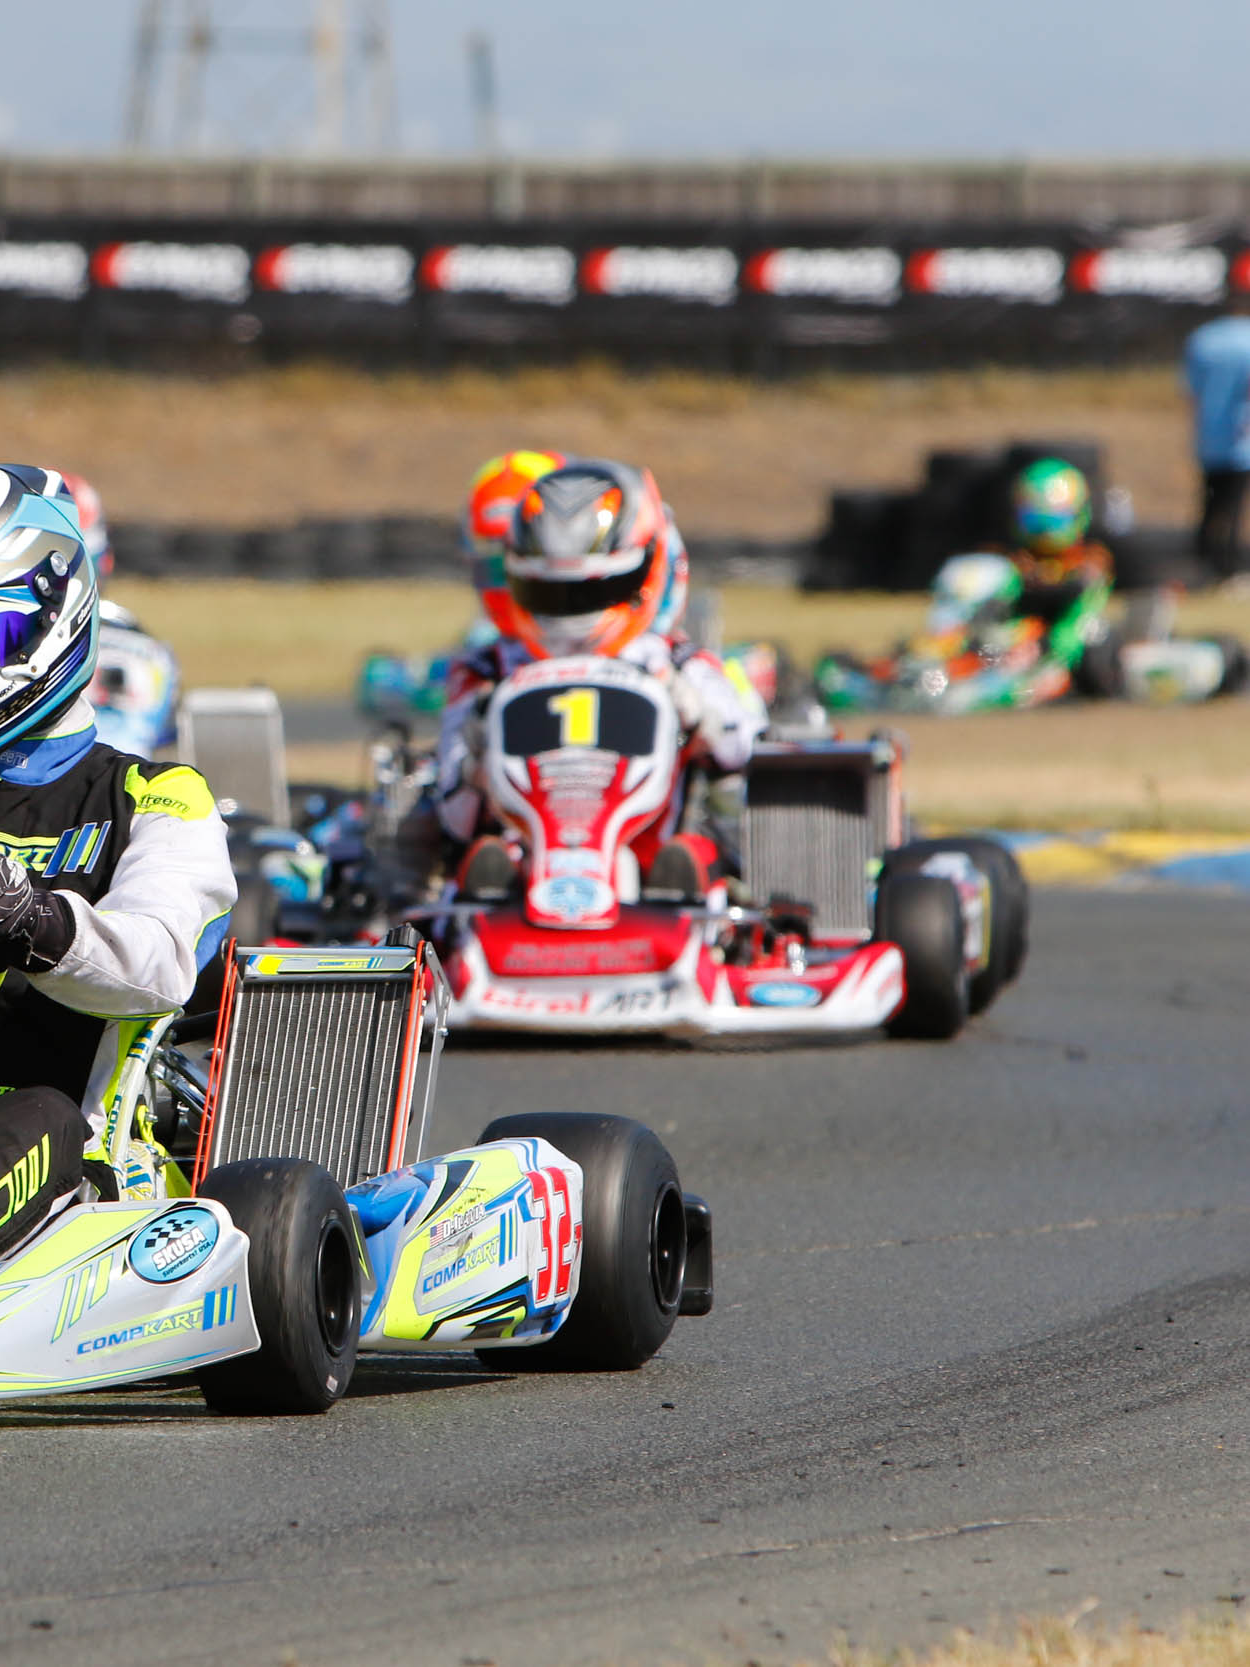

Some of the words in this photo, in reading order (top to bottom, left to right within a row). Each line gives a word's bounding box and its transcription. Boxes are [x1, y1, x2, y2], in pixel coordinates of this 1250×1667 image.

[549, 687, 600, 747] 1
[152, 1226, 207, 1271] SKUSA
[422, 1237, 499, 1294] COMPKART
[77, 1308, 203, 1355] COMPKART
